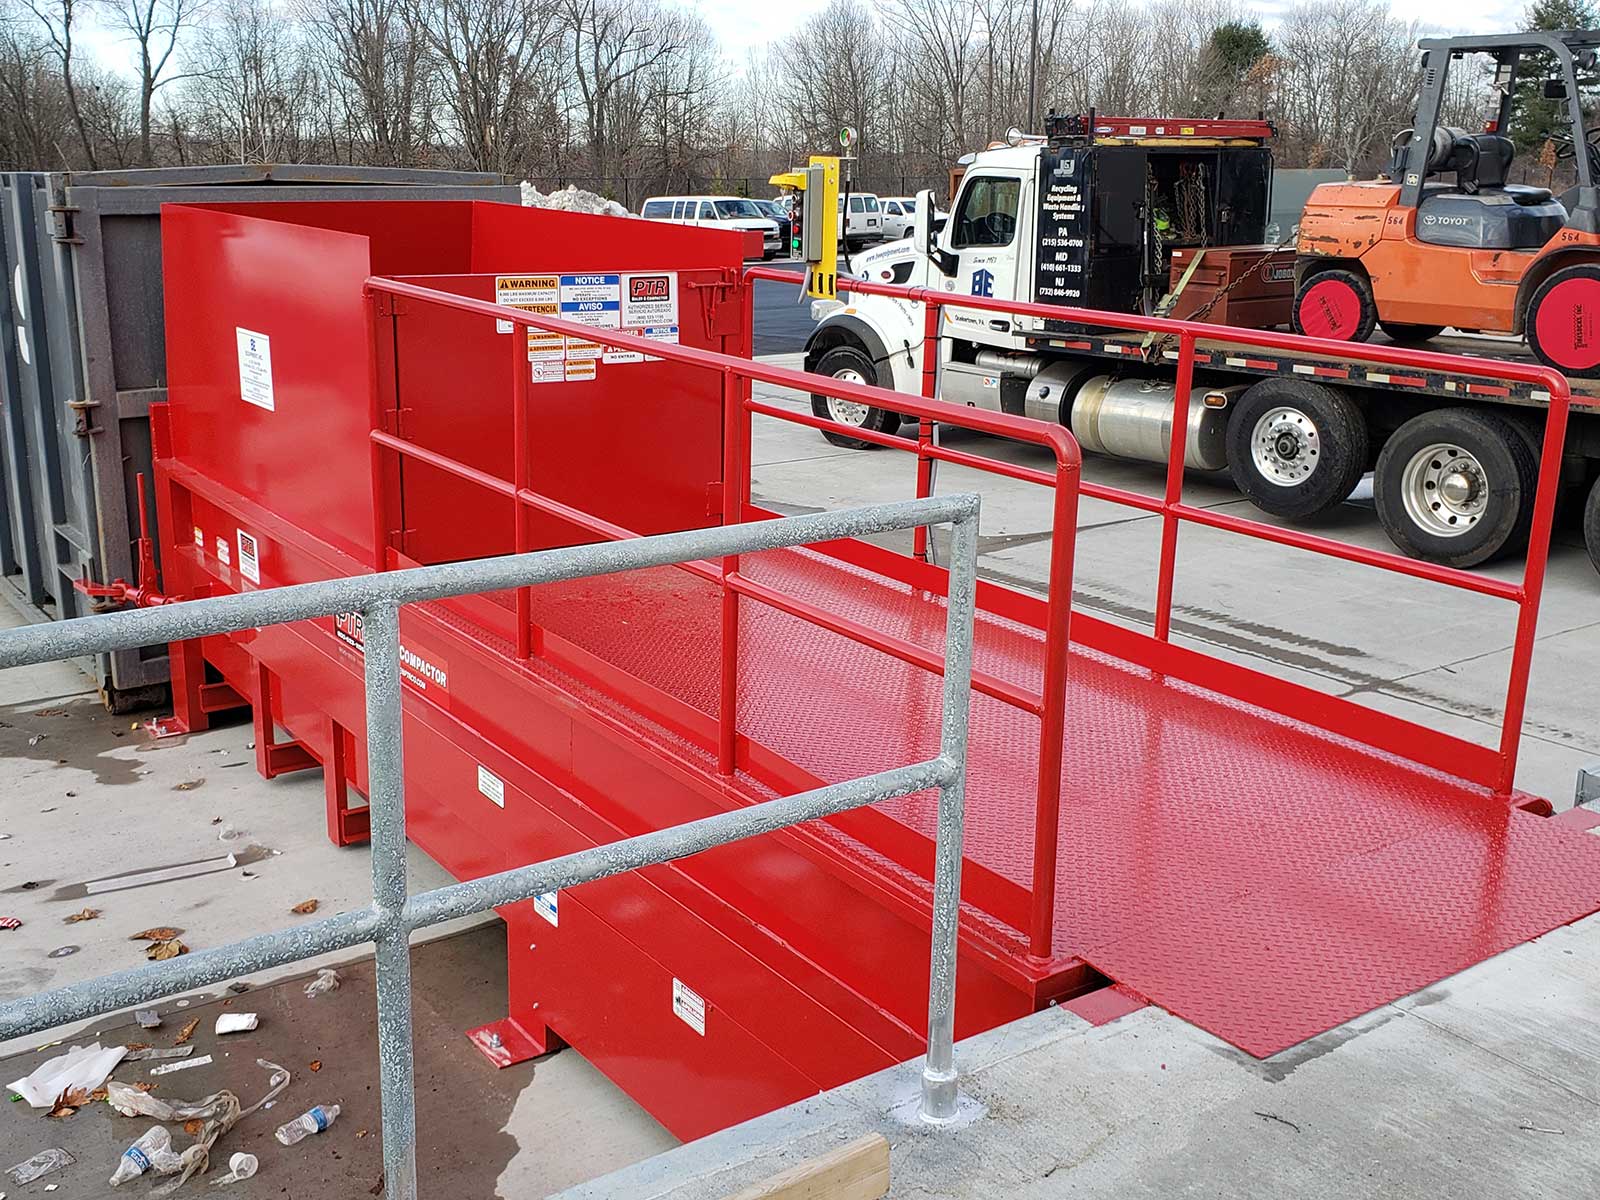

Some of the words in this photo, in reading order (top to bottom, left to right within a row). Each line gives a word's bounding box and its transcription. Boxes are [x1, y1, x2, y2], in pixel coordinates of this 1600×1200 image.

[1051, 185, 1077, 195] Recycling
[1047, 194, 1077, 203] Equipment
[1052, 212, 1075, 220] Systems
[1388, 216, 1404, 225] 564
[1058, 228, 1068, 236] PA
[1561, 232, 1580, 241] 564
[1042, 238, 1057, 247] (215)
[1055, 252, 1068, 261] MD
[1041, 263, 1055, 272] (410)
[510, 279, 555, 288] WARNING
[575, 276, 605, 285] NOTICE
[1055, 277, 1064, 287] NJ
[633, 280, 666, 295] PTR
[1039, 287, 1054, 296] (732)
[578, 303, 603, 311] AVISO
[400, 645, 447, 688] COMPACTOR
